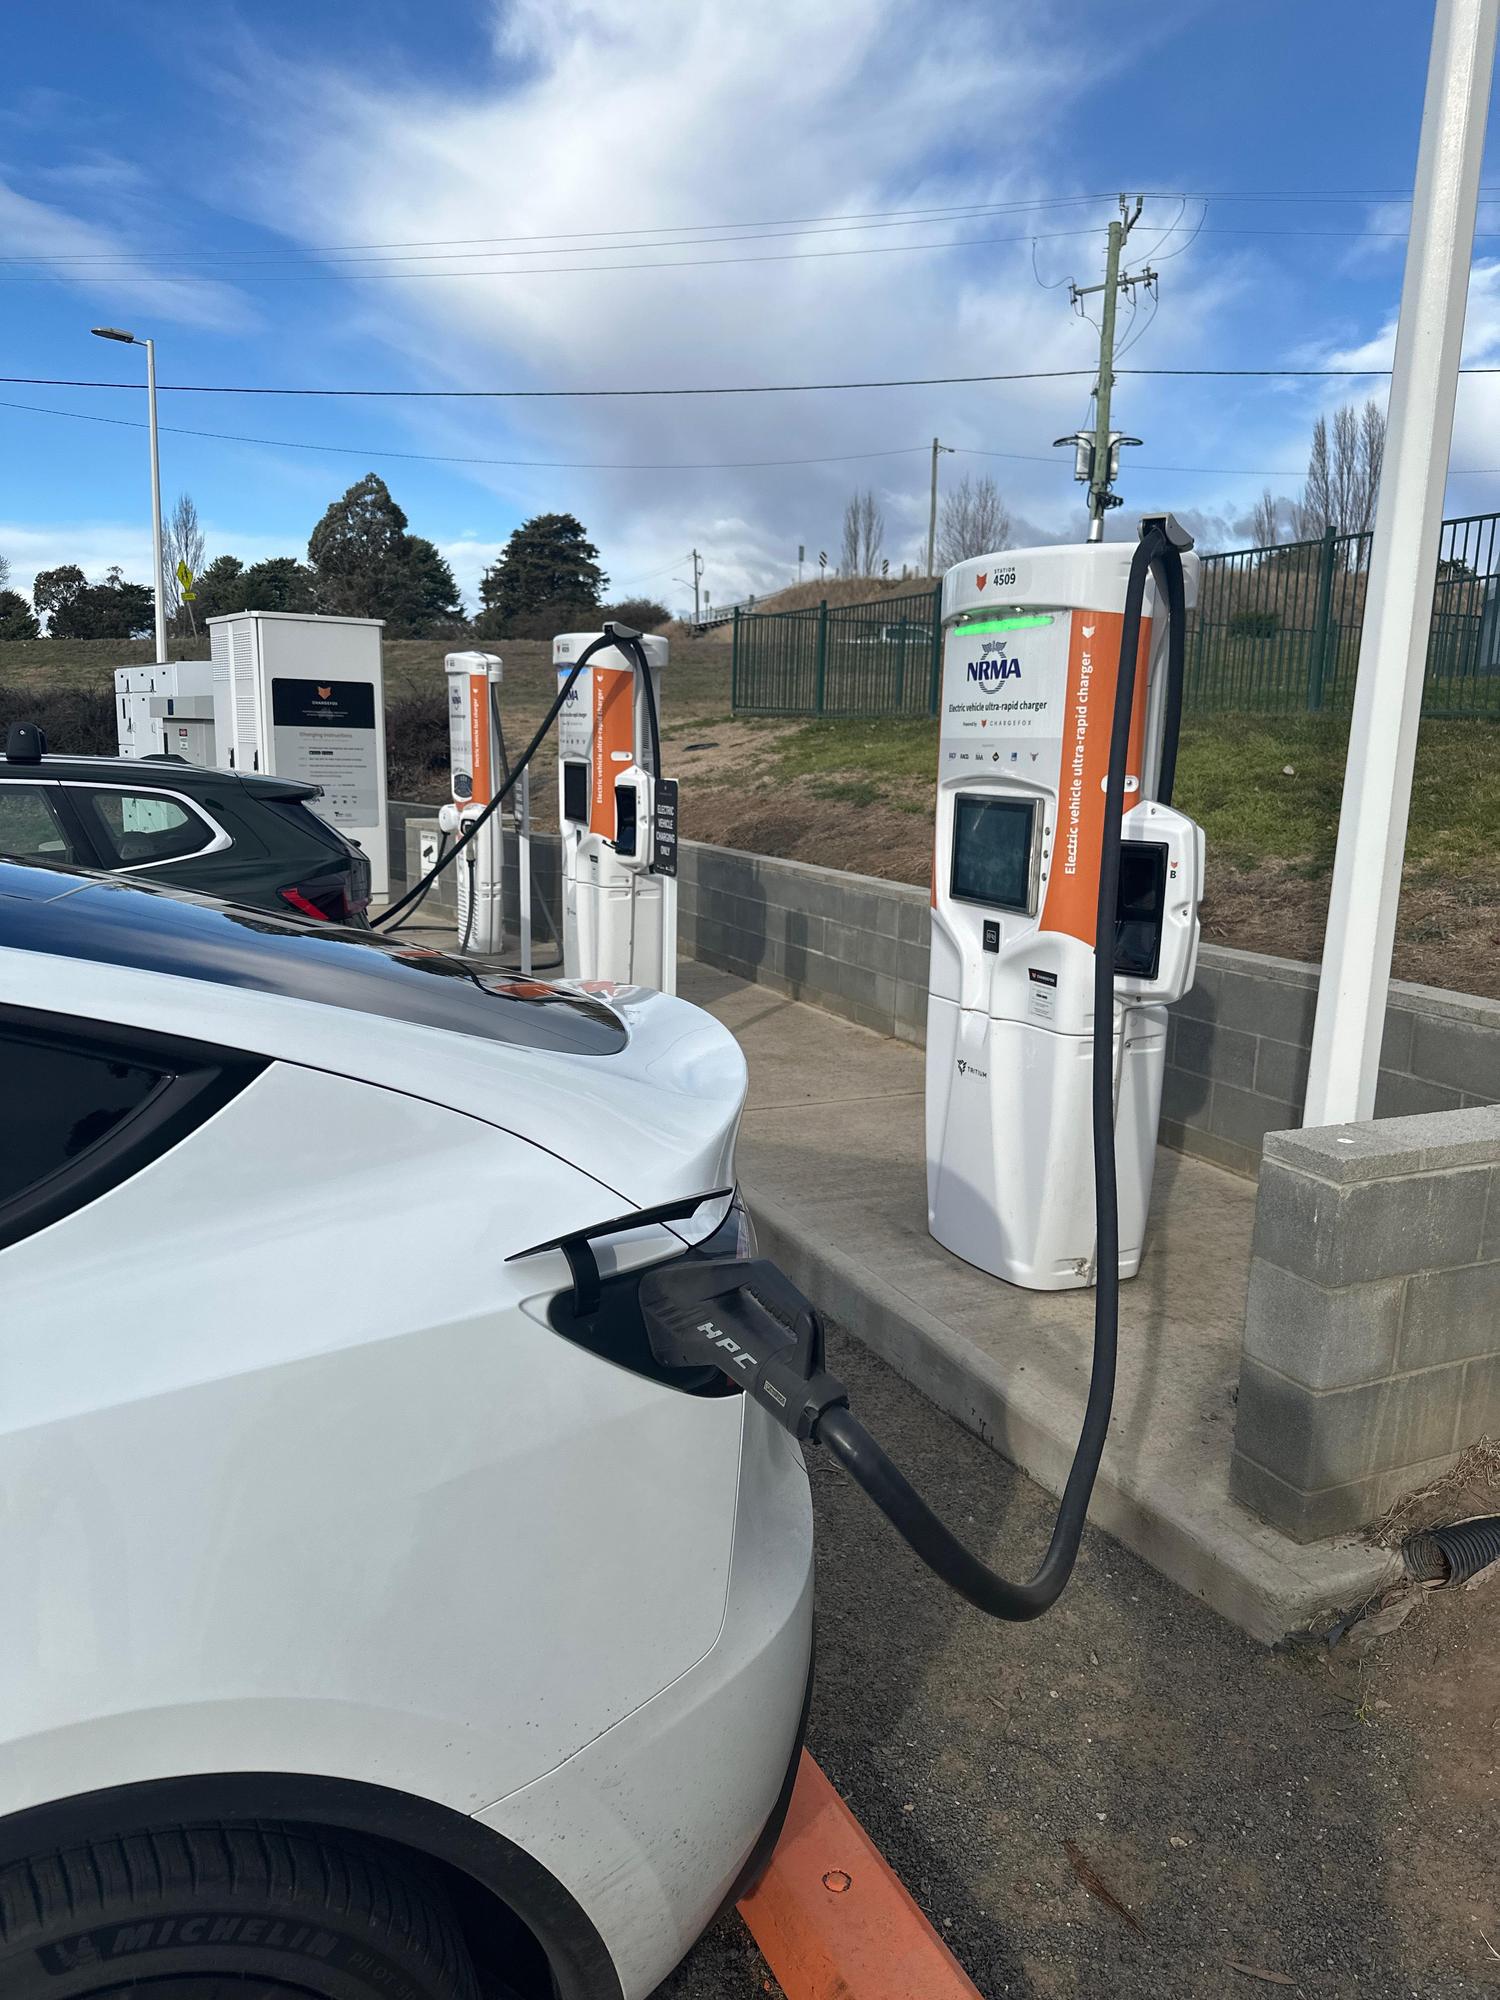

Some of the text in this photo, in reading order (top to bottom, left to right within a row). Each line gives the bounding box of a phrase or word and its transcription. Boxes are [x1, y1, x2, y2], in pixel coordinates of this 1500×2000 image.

[993, 573, 1016, 586] 4509
[967, 658, 1022, 681] NRMA
[949, 701, 1047, 713] Electric vehicle ultra-rapid charger
[1065, 651, 1094, 875] Electric vehicle ultra-rapid charger
[1170, 870, 1176, 878] B
[696, 1322, 758, 1369] HPC
[111, 1916, 339, 1958] MICHELIN
